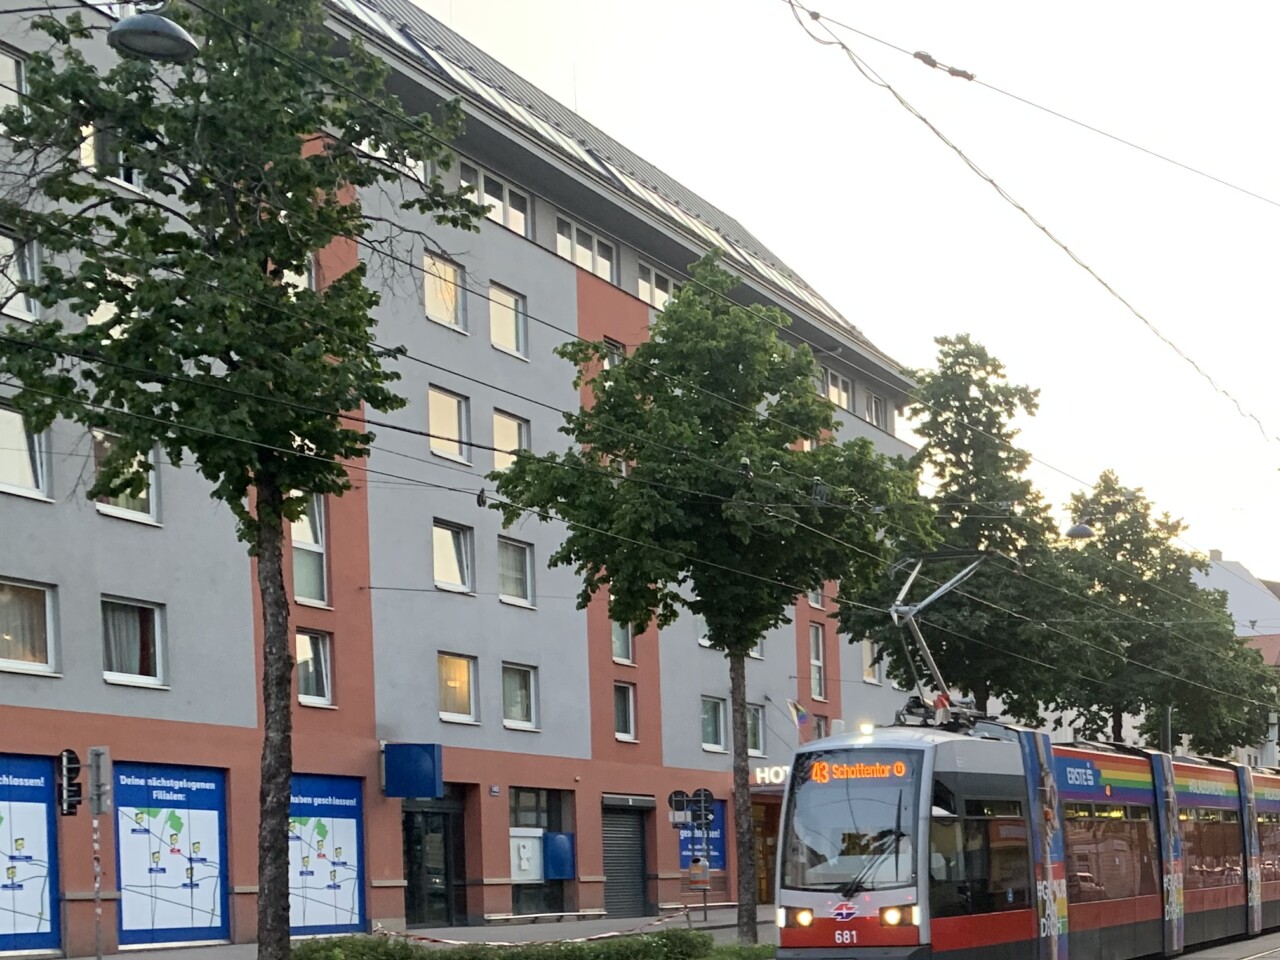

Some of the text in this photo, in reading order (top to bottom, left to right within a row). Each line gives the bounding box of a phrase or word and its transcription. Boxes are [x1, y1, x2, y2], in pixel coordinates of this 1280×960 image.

[811, 761, 830, 784] 43
[832, 762, 891, 779] Schottentor
[119, 775, 146, 786] Deine
[152, 790, 187, 802] Filialen:
[290, 794, 357, 807] haben geschlossen!
[835, 930, 857, 944] 681
